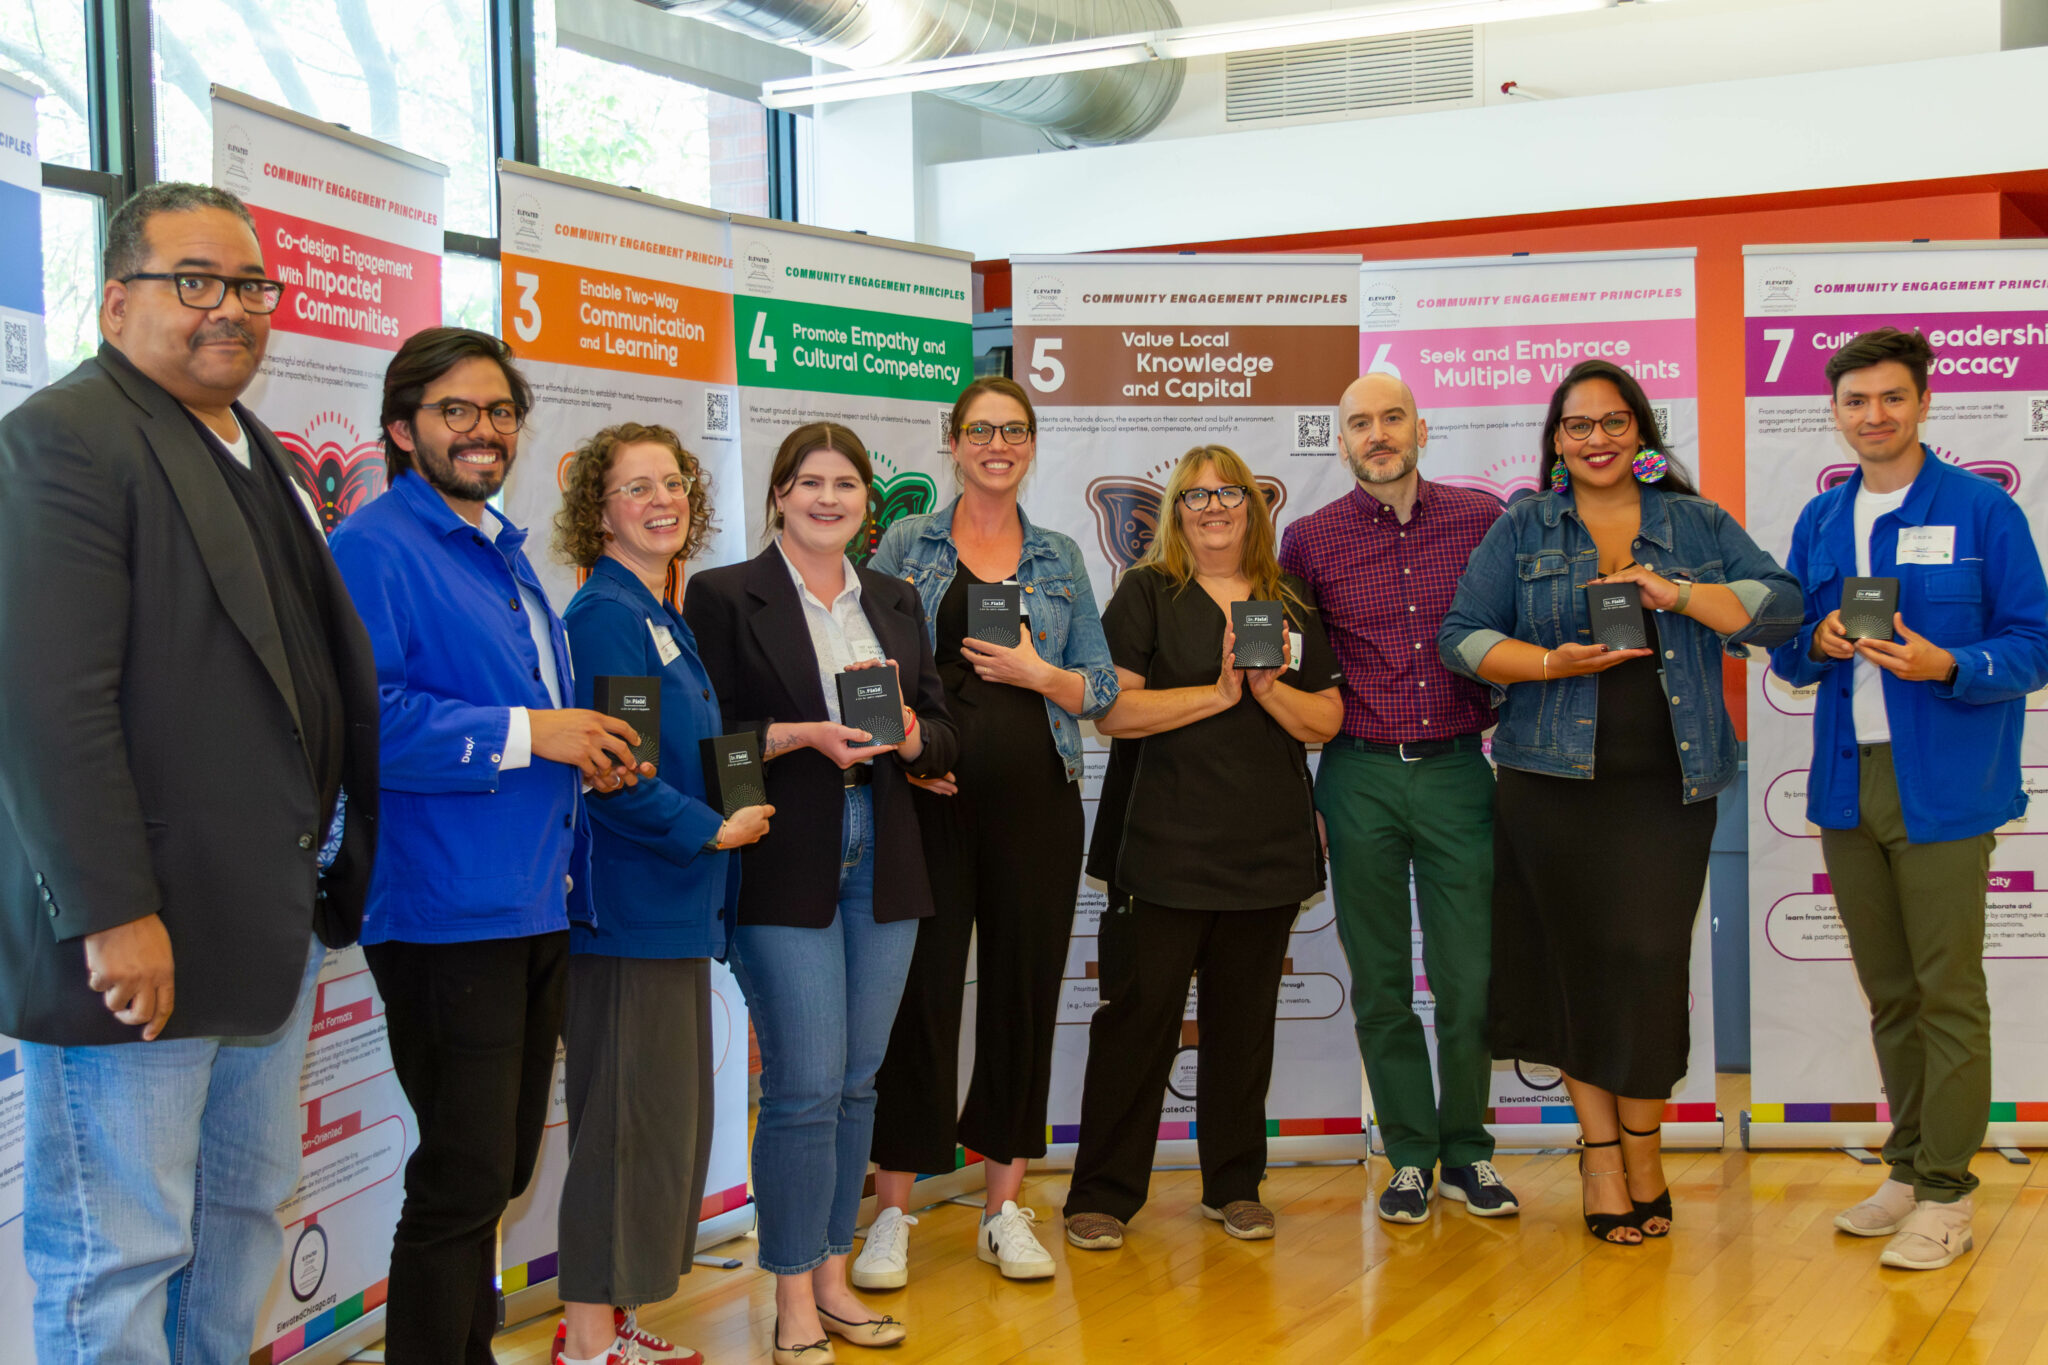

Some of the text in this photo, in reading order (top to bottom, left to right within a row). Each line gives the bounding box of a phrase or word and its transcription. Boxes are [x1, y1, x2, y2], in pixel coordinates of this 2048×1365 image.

[0, 131, 32, 157] CIPLES
[263, 162, 324, 192] COMMUNITY
[325, 181, 386, 211] ENGAGEMENT
[388, 200, 438, 226] PRINCIPLES
[276, 227, 413, 281] Co-design Engagement
[554, 223, 734, 269] COMMUNITY ENGAGEMENT PRINCIPLE
[277, 261, 381, 304] With Impacted
[785, 266, 965, 301] COMMUNITY ENGAGEMENT PRINCIPLES
[1814, 279, 2048, 294] COMMUNITY ENGAGEMENT PRINCI
[514, 271, 542, 343] 3
[580, 279, 679, 313] Enable Two-Way
[1082, 293, 1348, 304] COMMUNITY ENGAGEMENT PRINCIPLES
[1416, 288, 1683, 309] COMMUNITY ENGAGEMENT PRINCIPLES
[295, 292, 399, 339] Communities
[580, 303, 705, 342] Communication
[748, 310, 778, 373] 4
[793, 323, 946, 356] Promote Empathy and
[1122, 331, 1229, 348] Value Local
[1913, 323, 2048, 348] eadershi
[580, 332, 679, 367] and Learning
[1420, 338, 1631, 365] Seek and Embrace
[1763, 328, 1795, 383] 7
[792, 346, 961, 386] Cultural Competency
[1028, 338, 1066, 393] 5
[1136, 353, 1274, 377] Knowledge
[1434, 364, 1532, 390] Multiple
[1122, 378, 1251, 402] and Capital
[1056, 425, 1100, 434] acknowledge
[1118, 425, 1151, 434] expertise,
[1151, 426, 1193, 434] compensate,
[1208, 425, 1232, 434] amplify
[1073, 415, 1093, 423] hands
[1094, 415, 1115, 424] down,
[1116, 415, 1127, 423] the
[1128, 416, 1152, 425] experts
[1163, 415, 1178, 423] their
[1205, 415, 1218, 423] and
[1219, 415, 1233, 423] built
[1470, 421, 1485, 430] from
[1486, 422, 1509, 431] people
[1511, 420, 1524, 428] who
[1758, 418, 1800, 426] engagement
[1988, 876, 2011, 889] city
[1814, 902, 2032, 912] Our laborate and
[1814, 934, 1847, 942] participan
[326, 1011, 353, 1028] Formats
[1499, 1095, 1573, 1104] ElevatedChicago.
[303, 1124, 343, 1151] on-Oriented
[276, 1293, 338, 1333] ElevatedChicago.org
